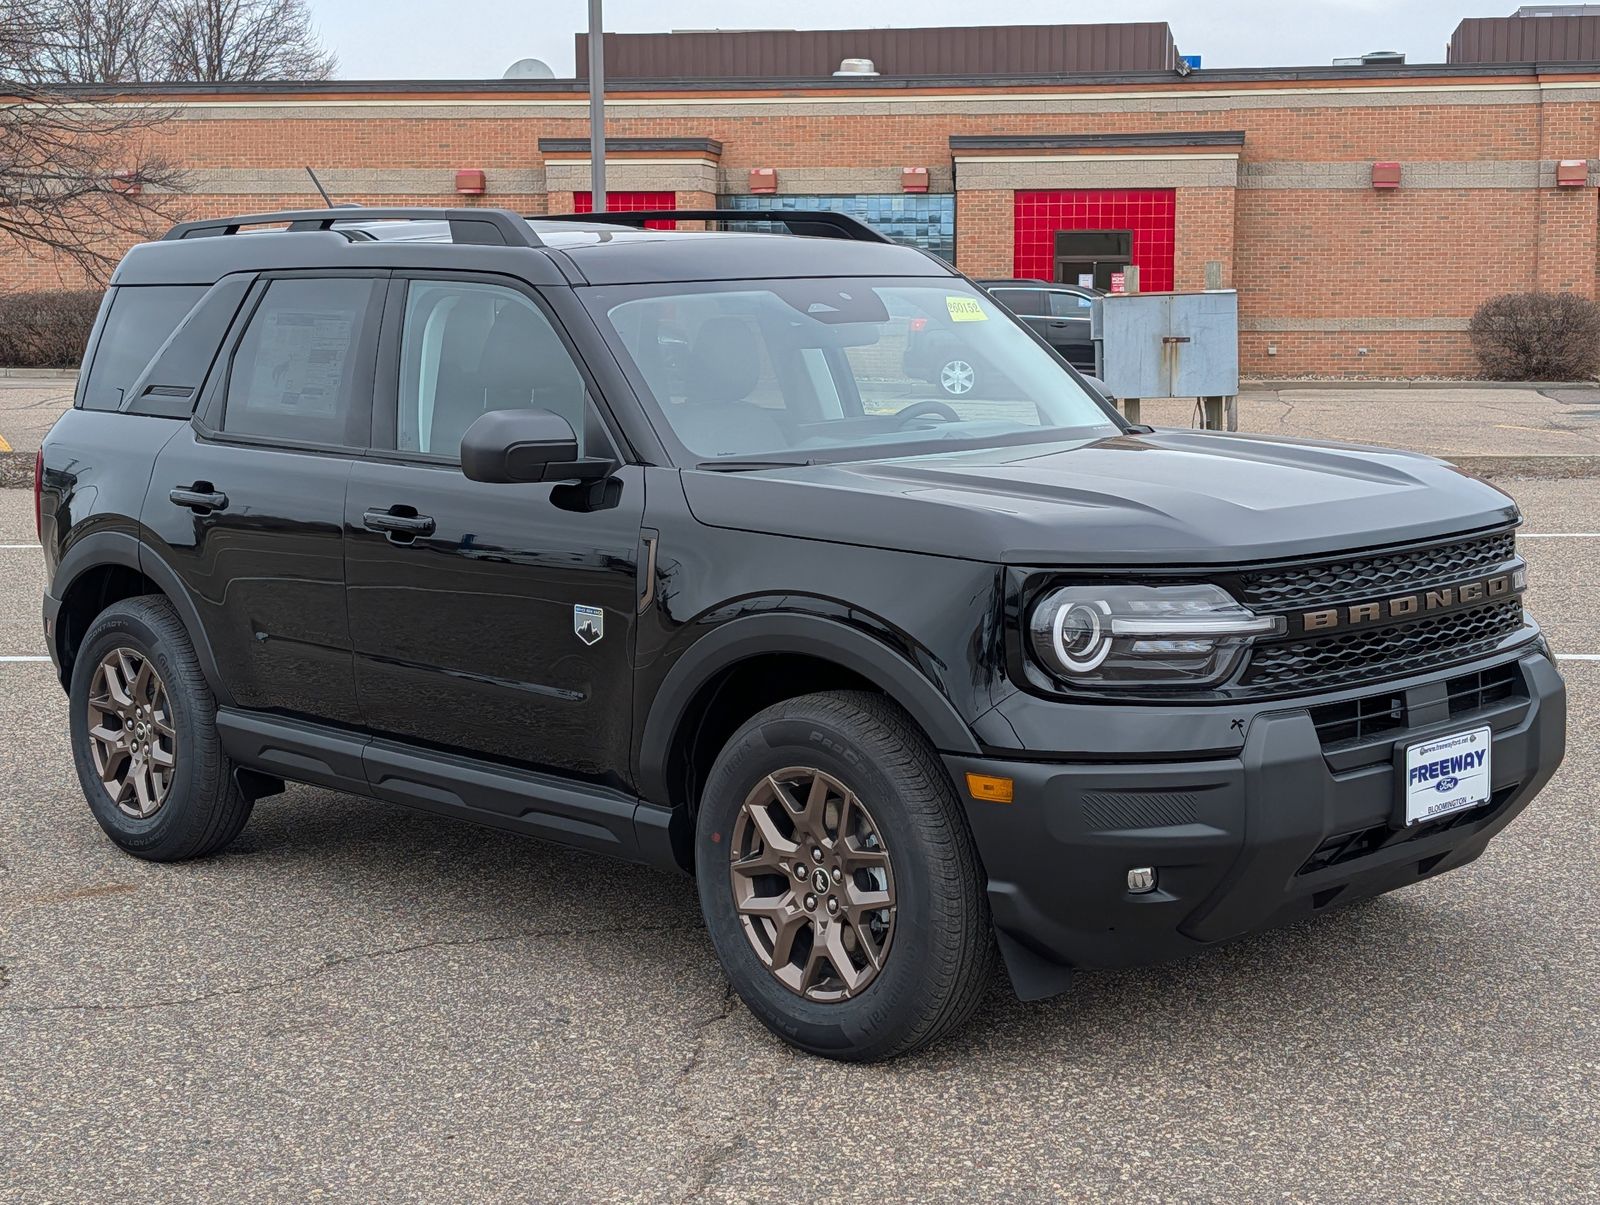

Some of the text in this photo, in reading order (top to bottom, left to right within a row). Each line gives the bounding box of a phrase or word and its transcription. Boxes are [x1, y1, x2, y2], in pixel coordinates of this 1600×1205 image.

[1304, 576, 1508, 631] BRONCO
[1410, 748, 1487, 787] FREEWAY
[1438, 778, 1456, 791] Ford
[1427, 796, 1468, 814] BLOOMINGTON
